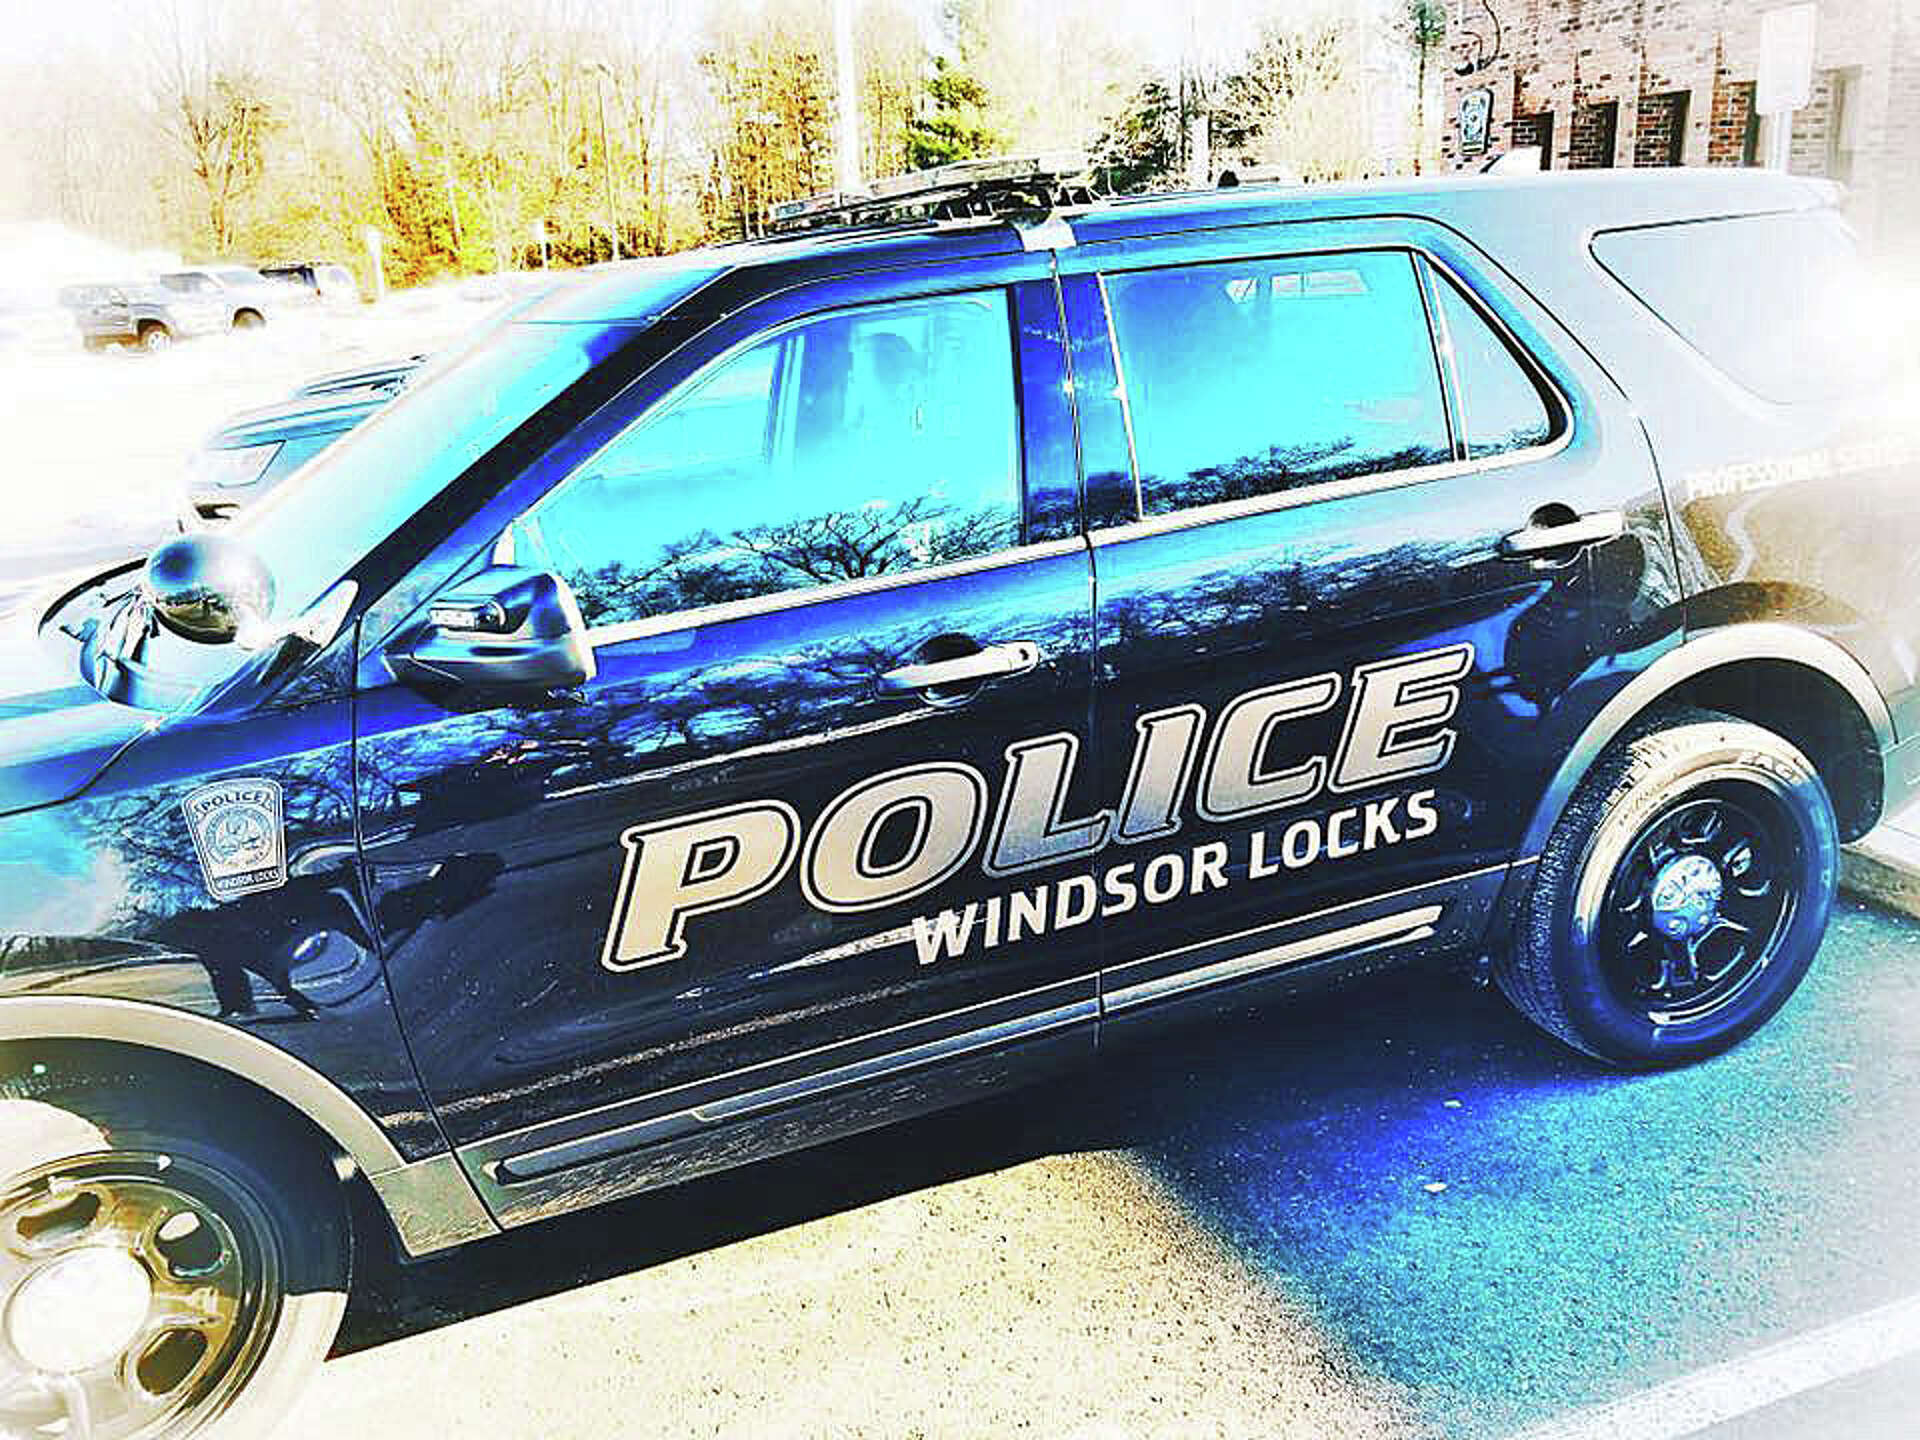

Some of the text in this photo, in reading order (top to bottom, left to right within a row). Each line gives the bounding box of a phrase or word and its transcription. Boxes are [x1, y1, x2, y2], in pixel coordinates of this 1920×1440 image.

[201, 790, 265, 812] POLICE
[602, 642, 1476, 973] POLICE
[913, 790, 1439, 966] WINDSOR LOCKS
